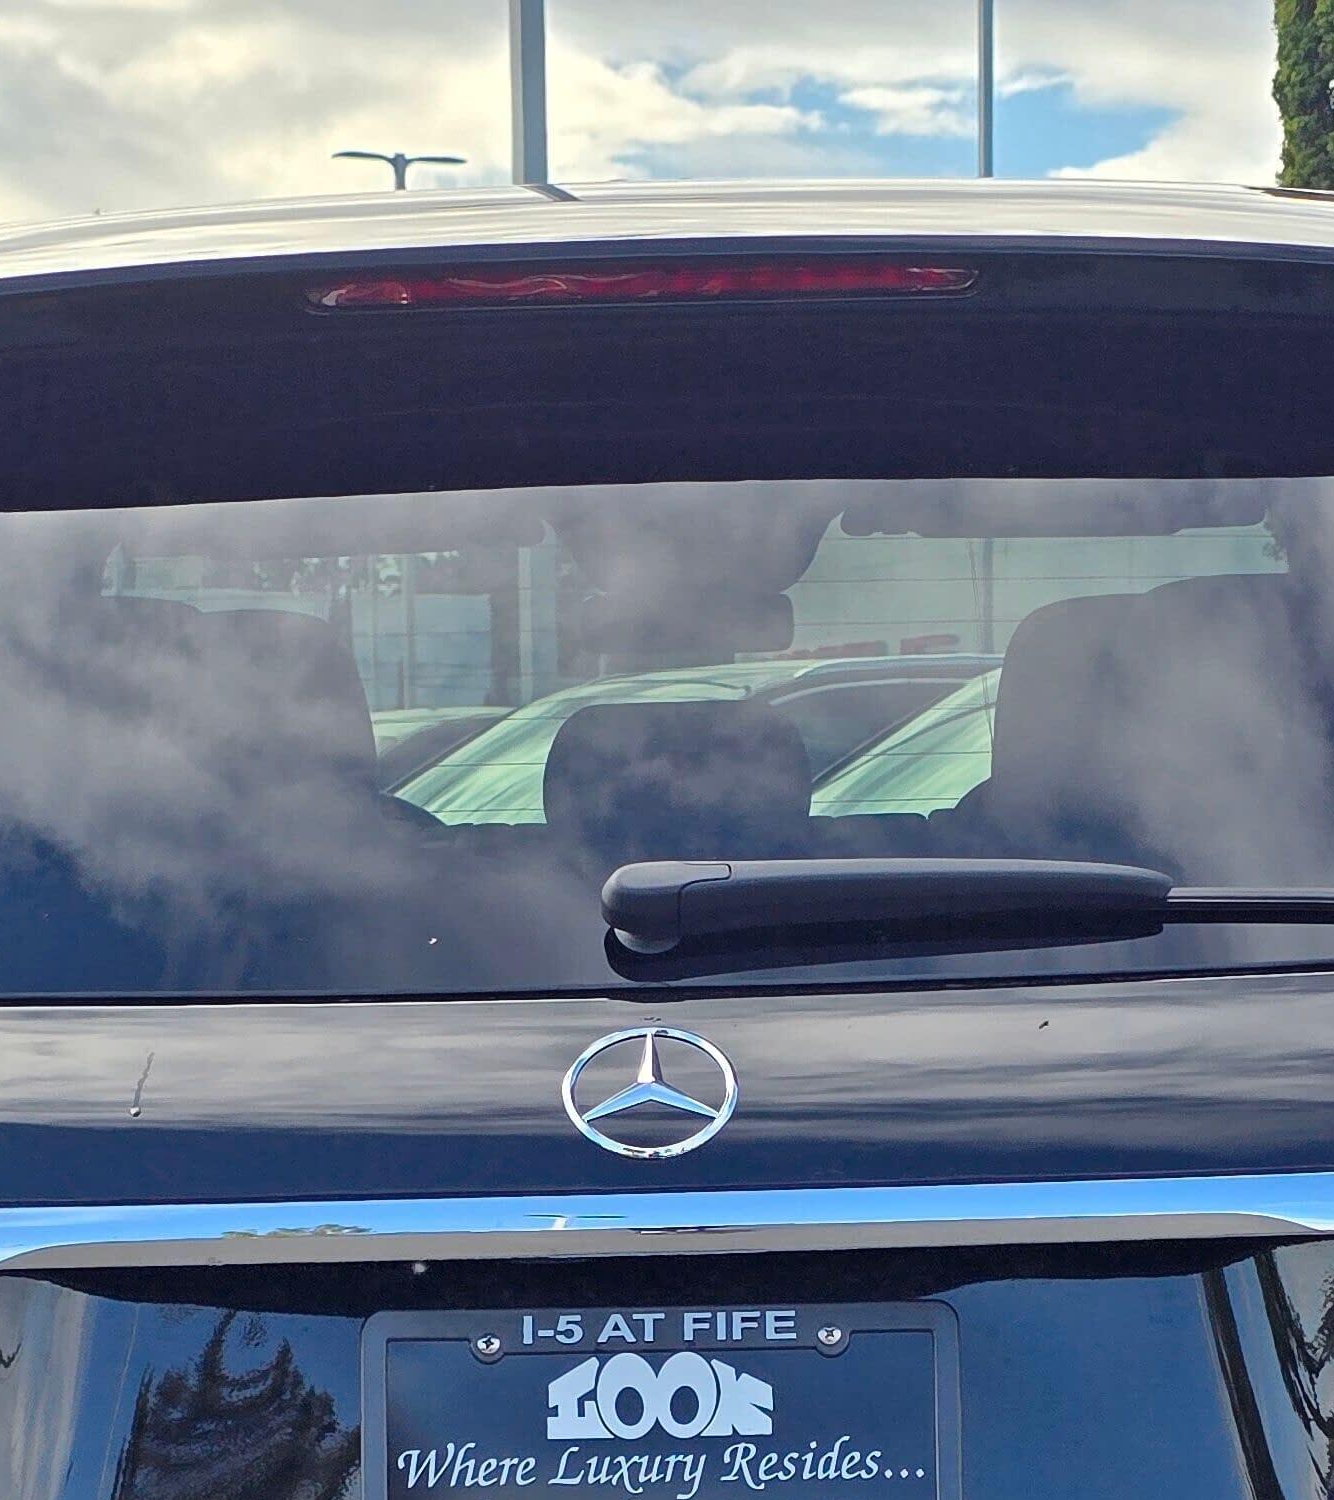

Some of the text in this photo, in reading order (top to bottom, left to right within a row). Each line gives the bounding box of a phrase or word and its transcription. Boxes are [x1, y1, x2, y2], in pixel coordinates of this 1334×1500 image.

[522, 1310, 797, 1345] I-5 AT FIFE
[546, 1351, 773, 1440] LOOK
[397, 1436, 927, 1499] Where Luxury Resides...
